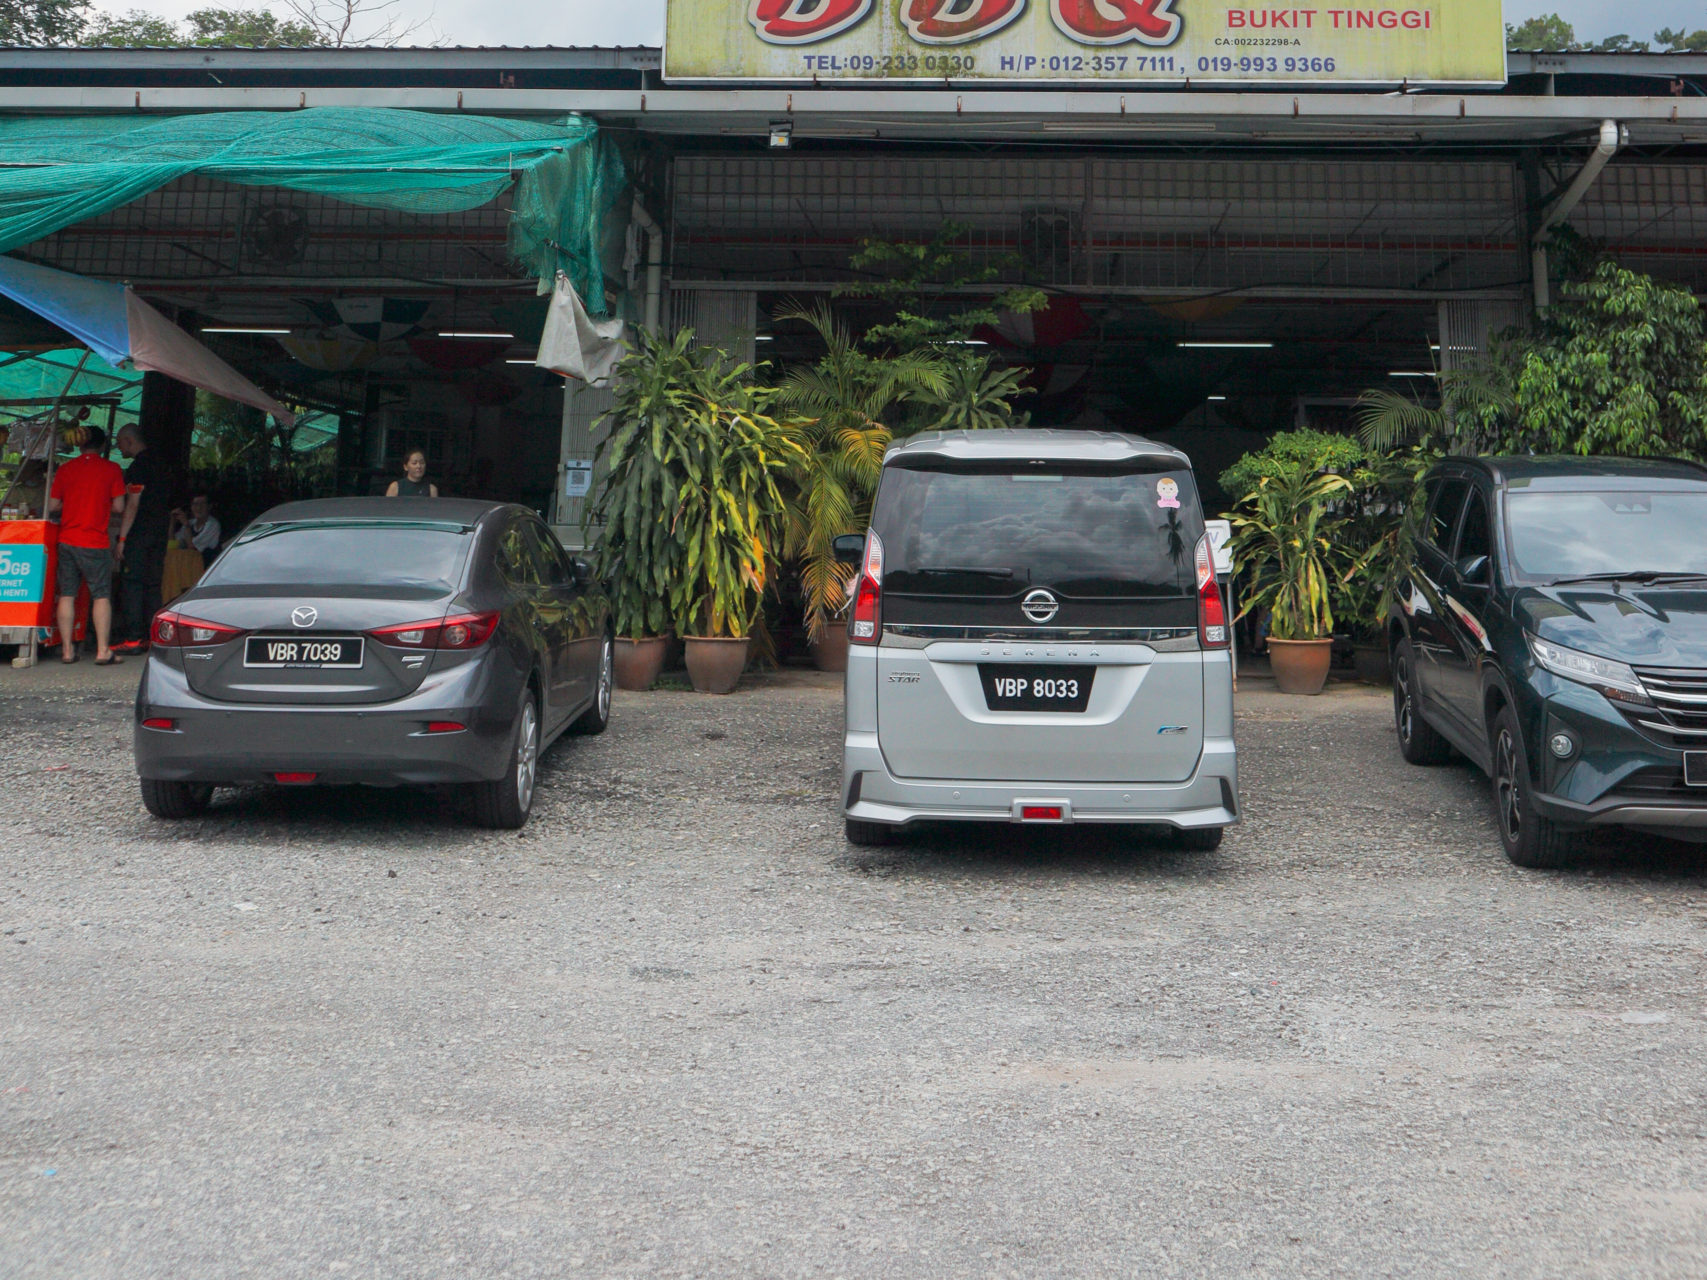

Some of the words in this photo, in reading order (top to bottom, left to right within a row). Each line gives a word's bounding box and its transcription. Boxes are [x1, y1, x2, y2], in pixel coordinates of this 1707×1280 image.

[1227, 10, 1317, 29] BUKIT
[1327, 10, 1431, 29] TINGGI
[1214, 37, 1301, 47] CA:002232298-A
[803, 55, 918, 70] TEL:09-233
[925, 55, 975, 71] 0330
[1197, 56, 1278, 72] 019-993
[1284, 57, 1336, 73] 9366
[267, 642, 298, 661] VBR
[301, 643, 342, 661] 7039
[980, 647, 1100, 657] SERENA
[888, 675, 920, 683] STAR
[994, 677, 1028, 698] VBP
[1033, 678, 1079, 698] 8033
